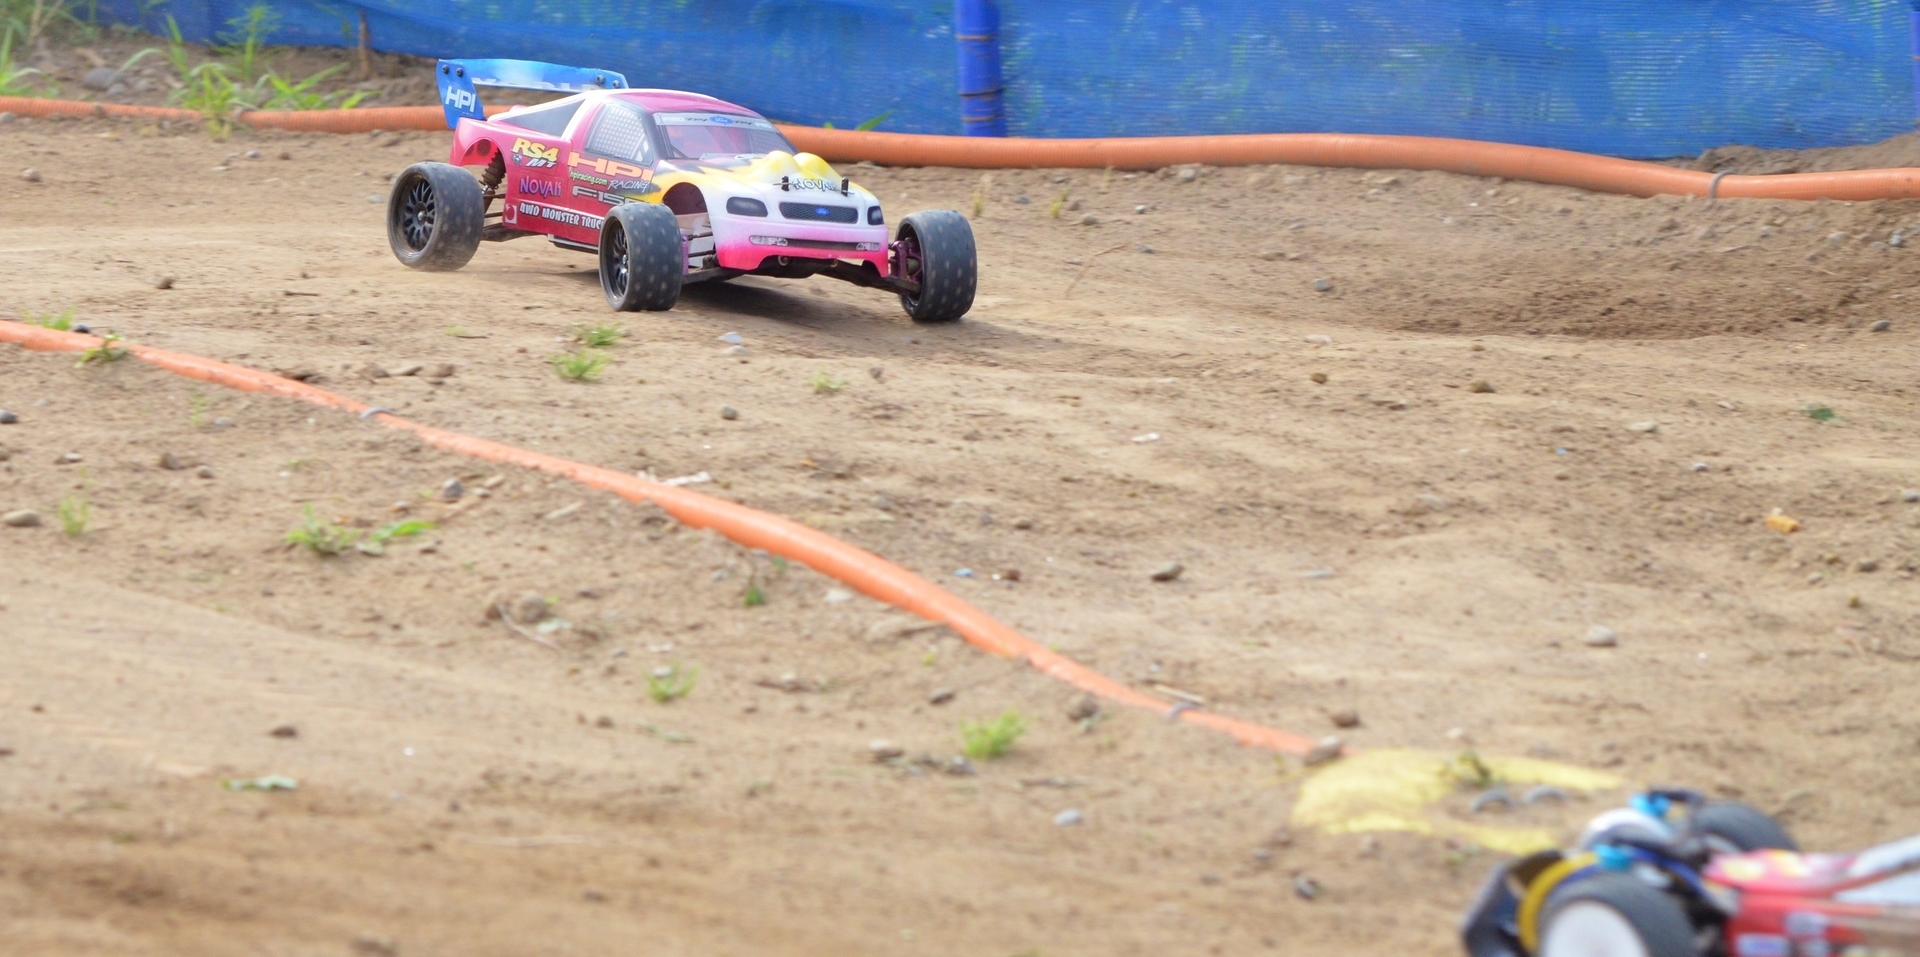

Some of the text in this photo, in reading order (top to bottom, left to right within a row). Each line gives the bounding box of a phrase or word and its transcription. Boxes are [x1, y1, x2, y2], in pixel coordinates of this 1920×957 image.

[445, 86, 475, 113] HPI
[511, 137, 559, 162] RS4
[525, 158, 557, 168] MT
[567, 151, 655, 182] HPI
[570, 169, 608, 184] hpiracing.com
[607, 179, 650, 193] RACING
[572, 185, 648, 206] F-15
[520, 202, 603, 230] 4WD MONSTER TRUC
